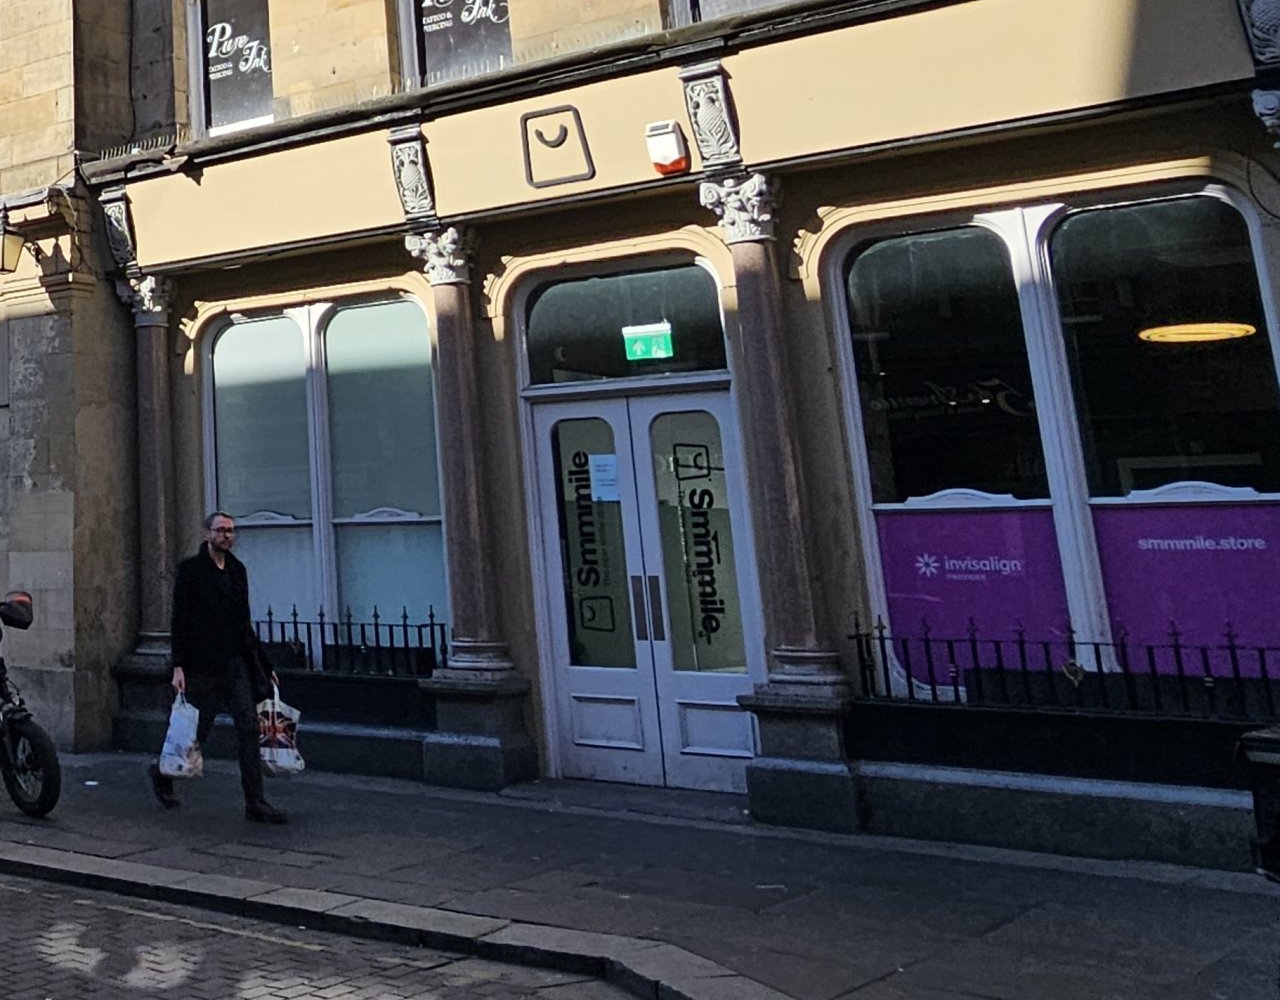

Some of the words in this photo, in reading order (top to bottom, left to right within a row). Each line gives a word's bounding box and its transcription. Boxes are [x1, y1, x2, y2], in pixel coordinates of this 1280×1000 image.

[207, 22, 249, 58] Pure
[1138, 535, 1266, 550] smmmile.store
[943, 555, 1022, 576] invisalign
